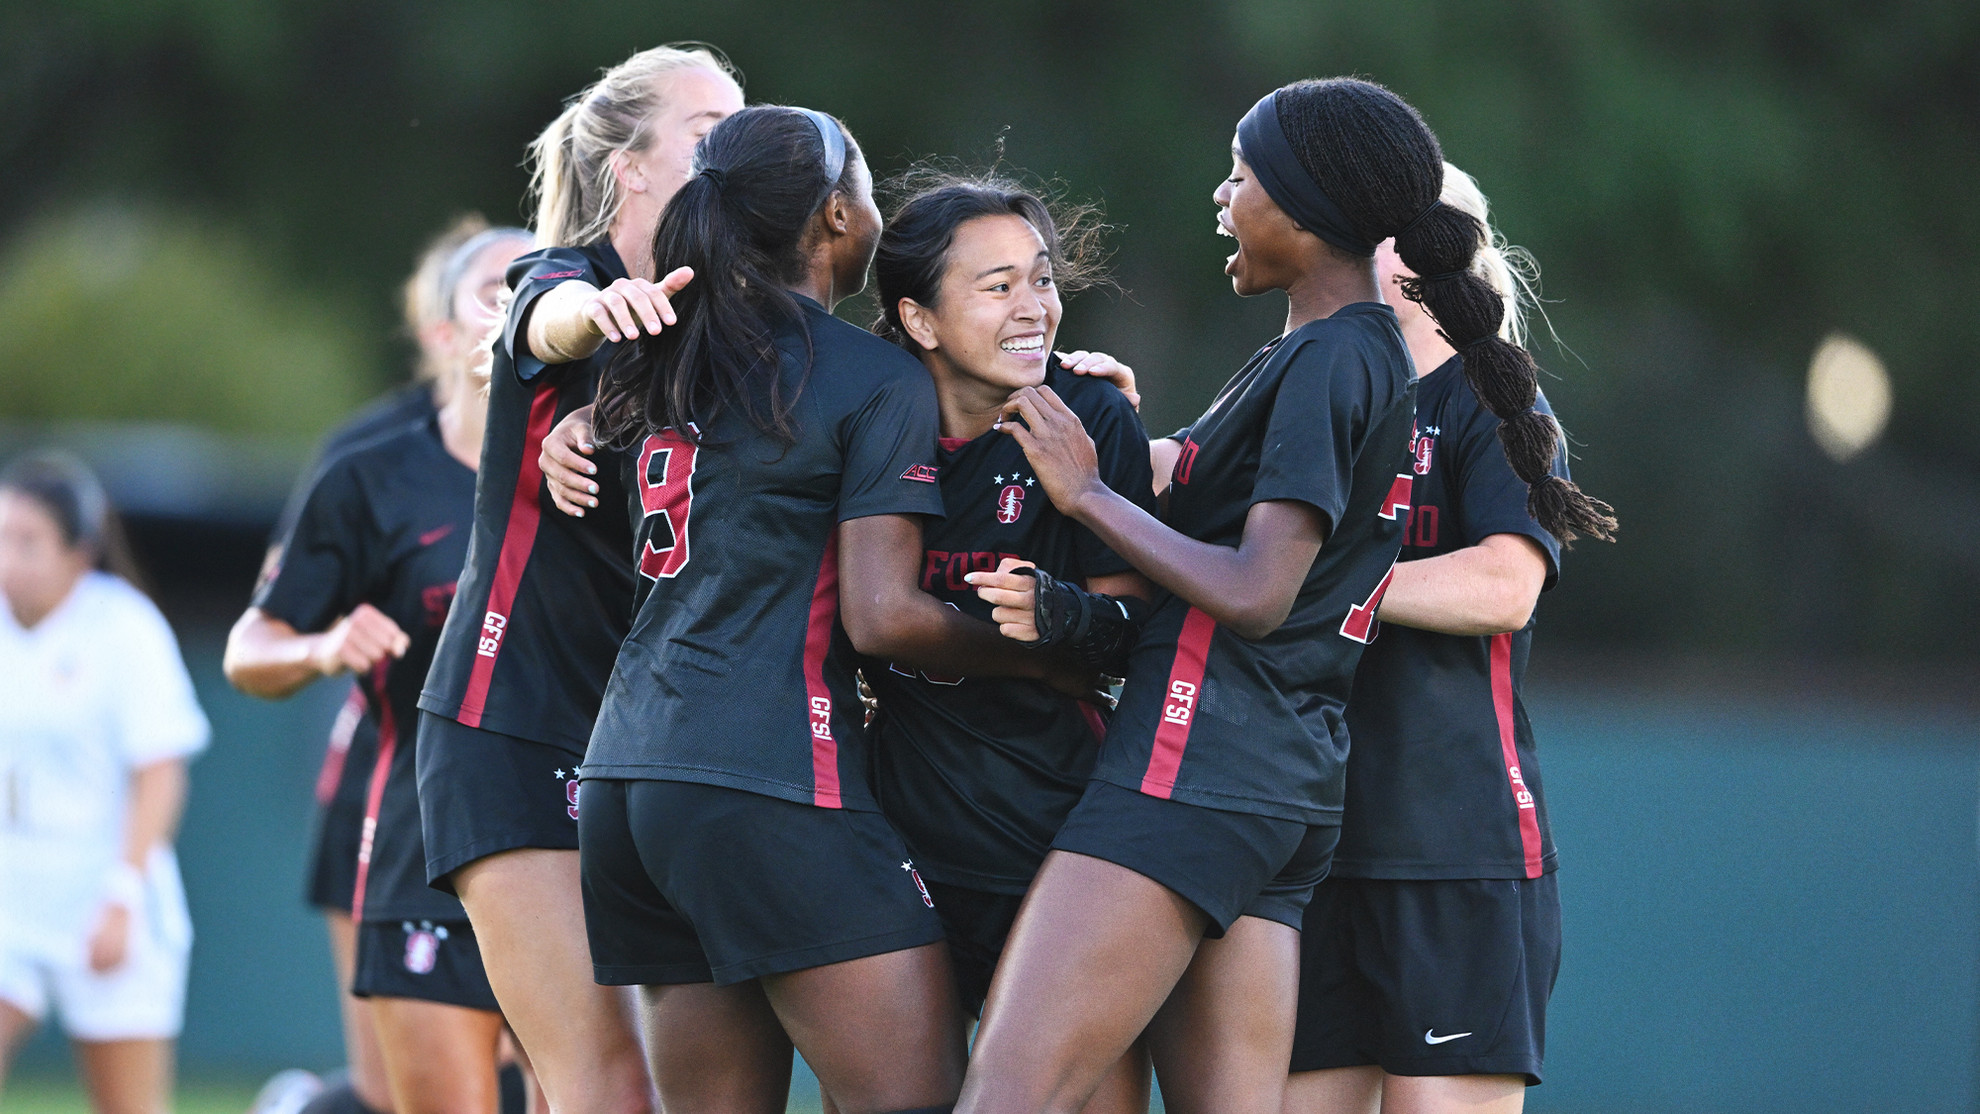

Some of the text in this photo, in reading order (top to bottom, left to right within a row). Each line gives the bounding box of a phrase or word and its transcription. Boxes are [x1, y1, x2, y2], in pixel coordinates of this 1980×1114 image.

[900, 462, 941, 483] ACC
[636, 421, 702, 582] 9
[996, 485, 1025, 524] S
[477, 611, 507, 658] GFSI
[811, 696, 832, 741] GFSI
[1164, 679, 1196, 726] GFSI
